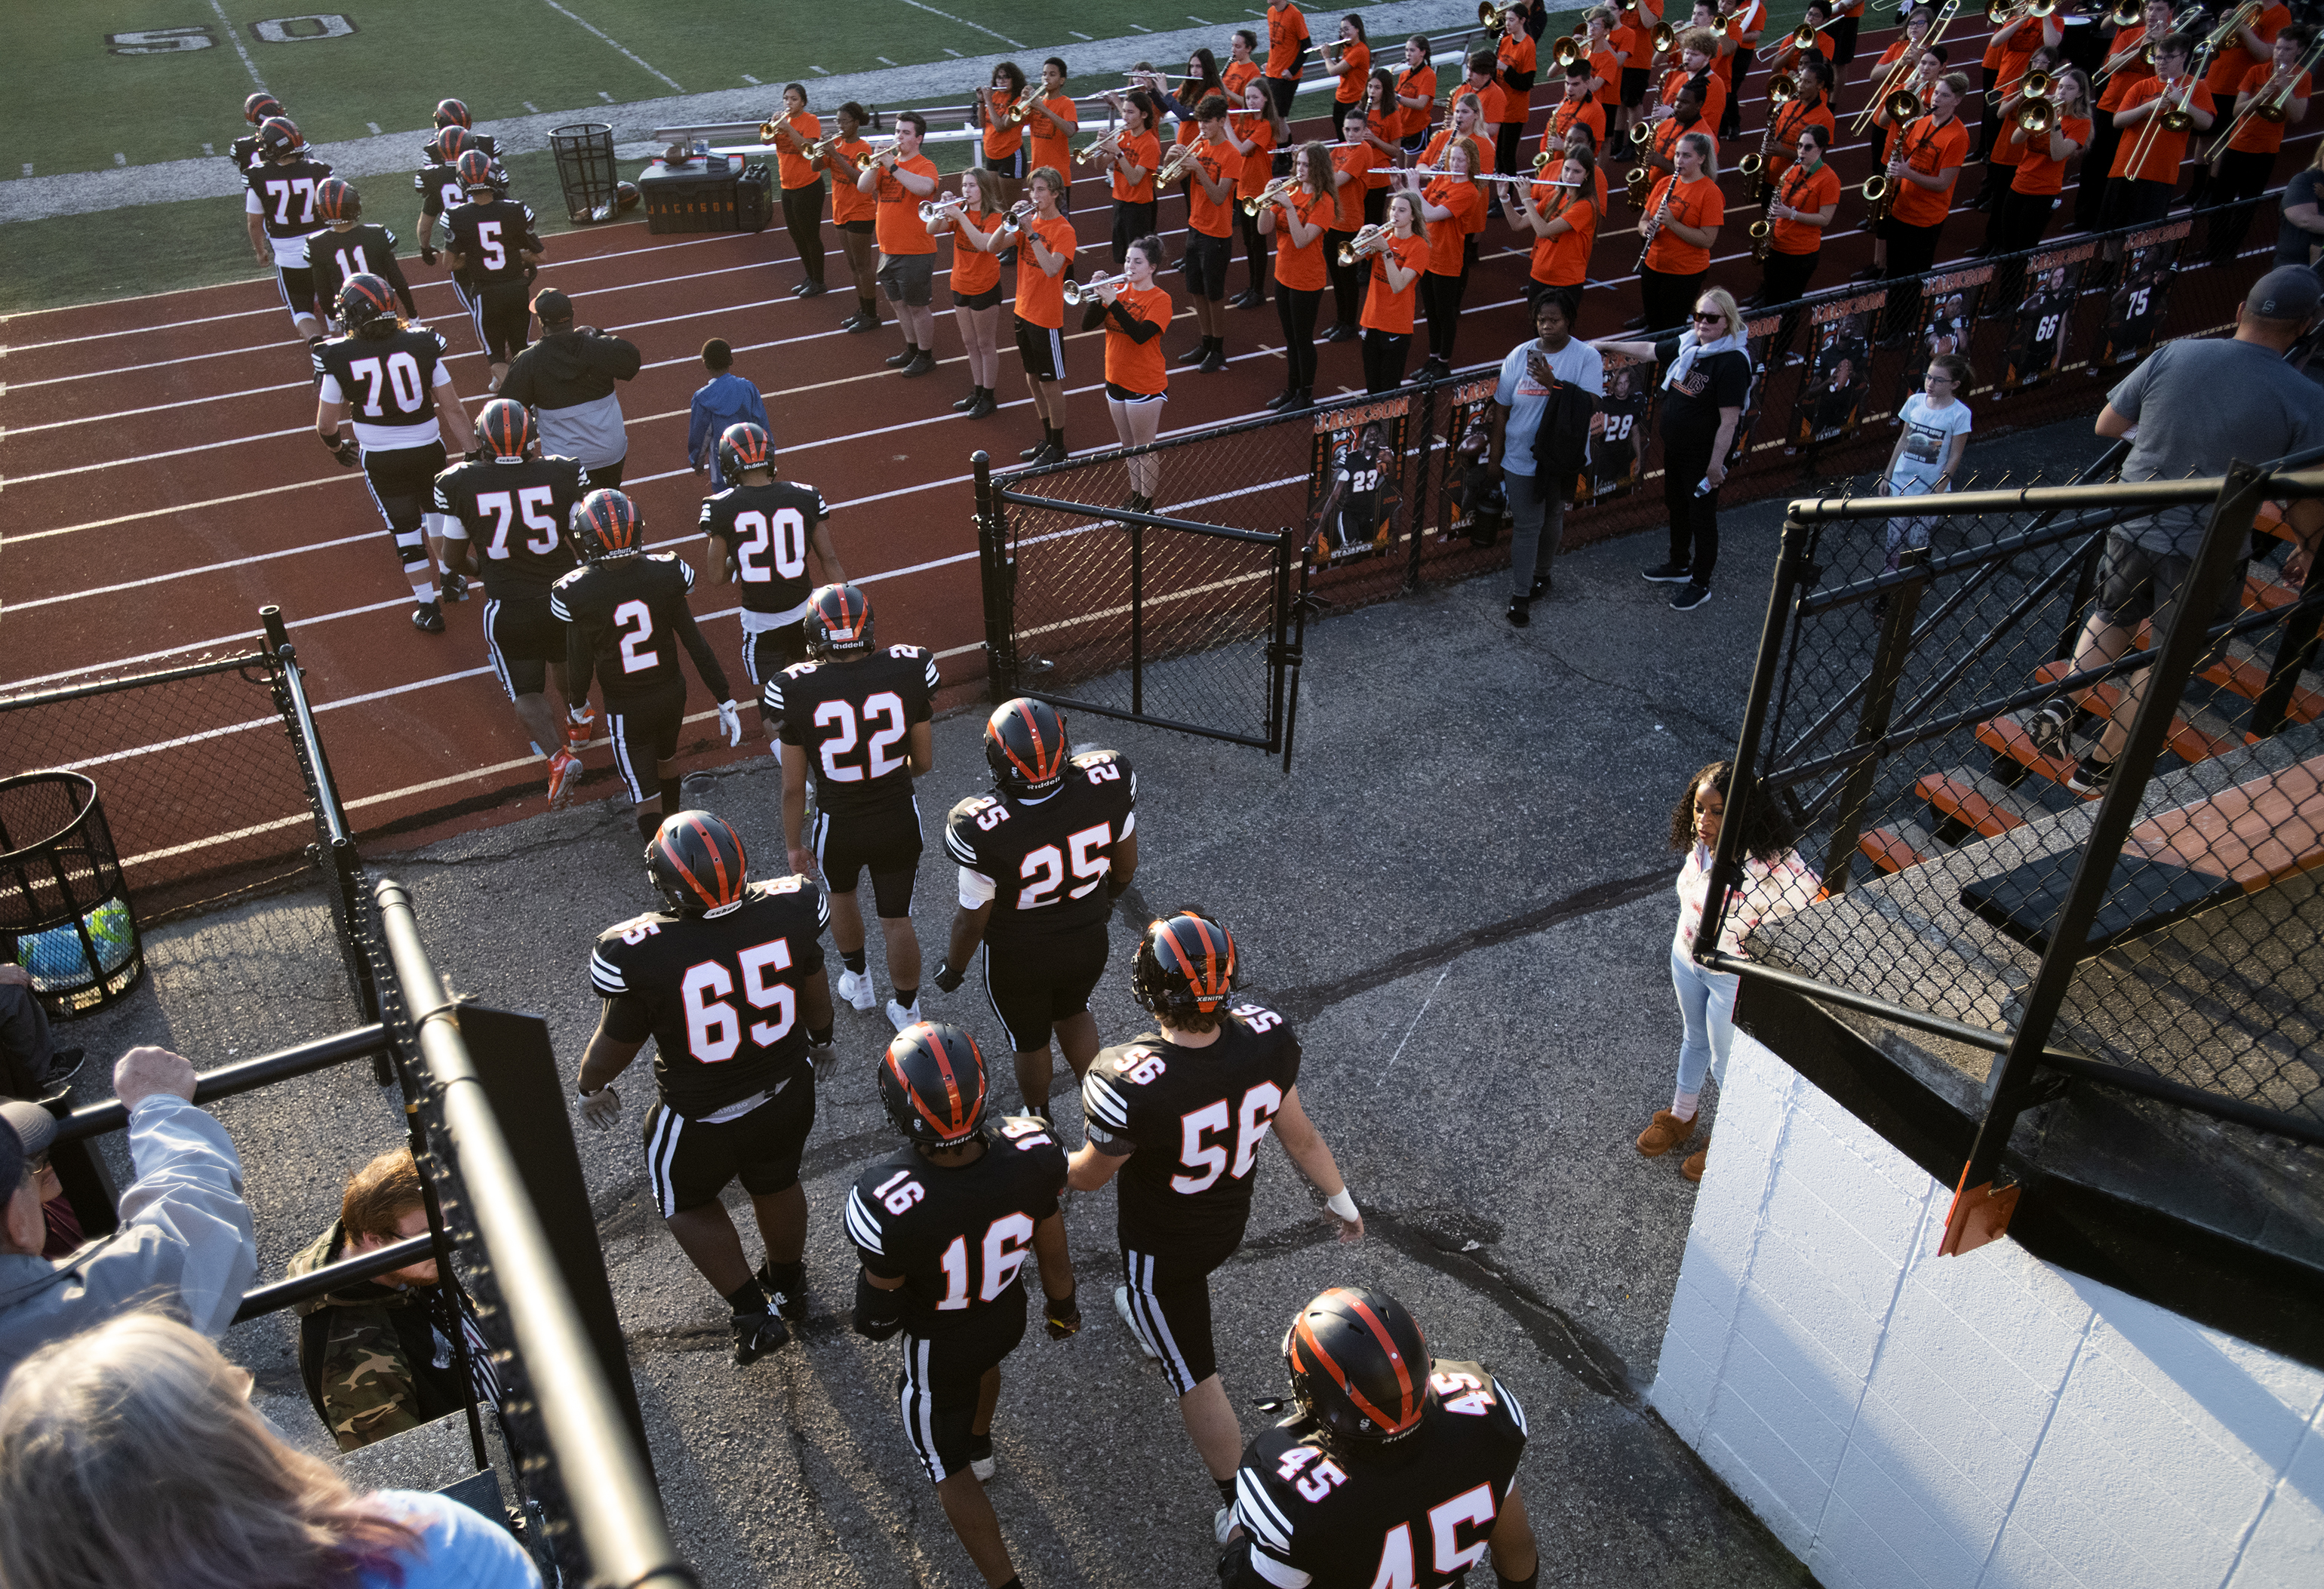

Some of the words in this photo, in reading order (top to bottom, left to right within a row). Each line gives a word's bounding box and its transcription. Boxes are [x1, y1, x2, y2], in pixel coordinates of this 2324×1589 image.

[104, 14, 361, 55] 50
[266, 178, 315, 225] 77
[648, 202, 734, 214] JACKSON
[478, 221, 506, 271] 5
[2124, 220, 2193, 252] JACKSON
[335, 245, 370, 280] 11
[2027, 241, 2098, 275] JACKSON
[1922, 265, 1996, 297] JACKSON
[1812, 290, 1888, 326] JACKSON
[2126, 287, 2151, 321] 75
[2035, 314, 2060, 342] 66
[349, 351, 423, 416] 70
[1452, 377, 1500, 407] JACK
[1314, 395, 1409, 435] JACKSON
[1605, 413, 1634, 442] 28
[1313, 435, 1324, 498] VARSITY
[1353, 469, 1379, 493] 23
[476, 485, 560, 560] 75
[609, 546, 632, 556] schutt
[733, 507, 805, 582] 20
[613, 598, 659, 674] 2
[832, 641, 864, 650] Riddell
[813, 690, 906, 782] 22
[1027, 776, 1061, 790] Riddell
[1078, 754, 1121, 785] 25
[964, 796, 1011, 831] 25
[1015, 821, 1111, 910] 25
[681, 937, 796, 1064] 65
[1231, 1003, 1283, 1034] 56
[1113, 1046, 1167, 1086] 56
[712, 1102, 749, 1116] AMPRO
[935, 1130, 979, 1147] Riddell
[1001, 1121, 1053, 1151] 16
[1169, 1080, 1282, 1194] 56
[873, 1169, 925, 1216] 16
[935, 1210, 1035, 1311] 16
[1431, 1372, 1496, 1416] 45
[1276, 1446, 1350, 1504] 45
[1370, 1481, 1496, 1589] 45
